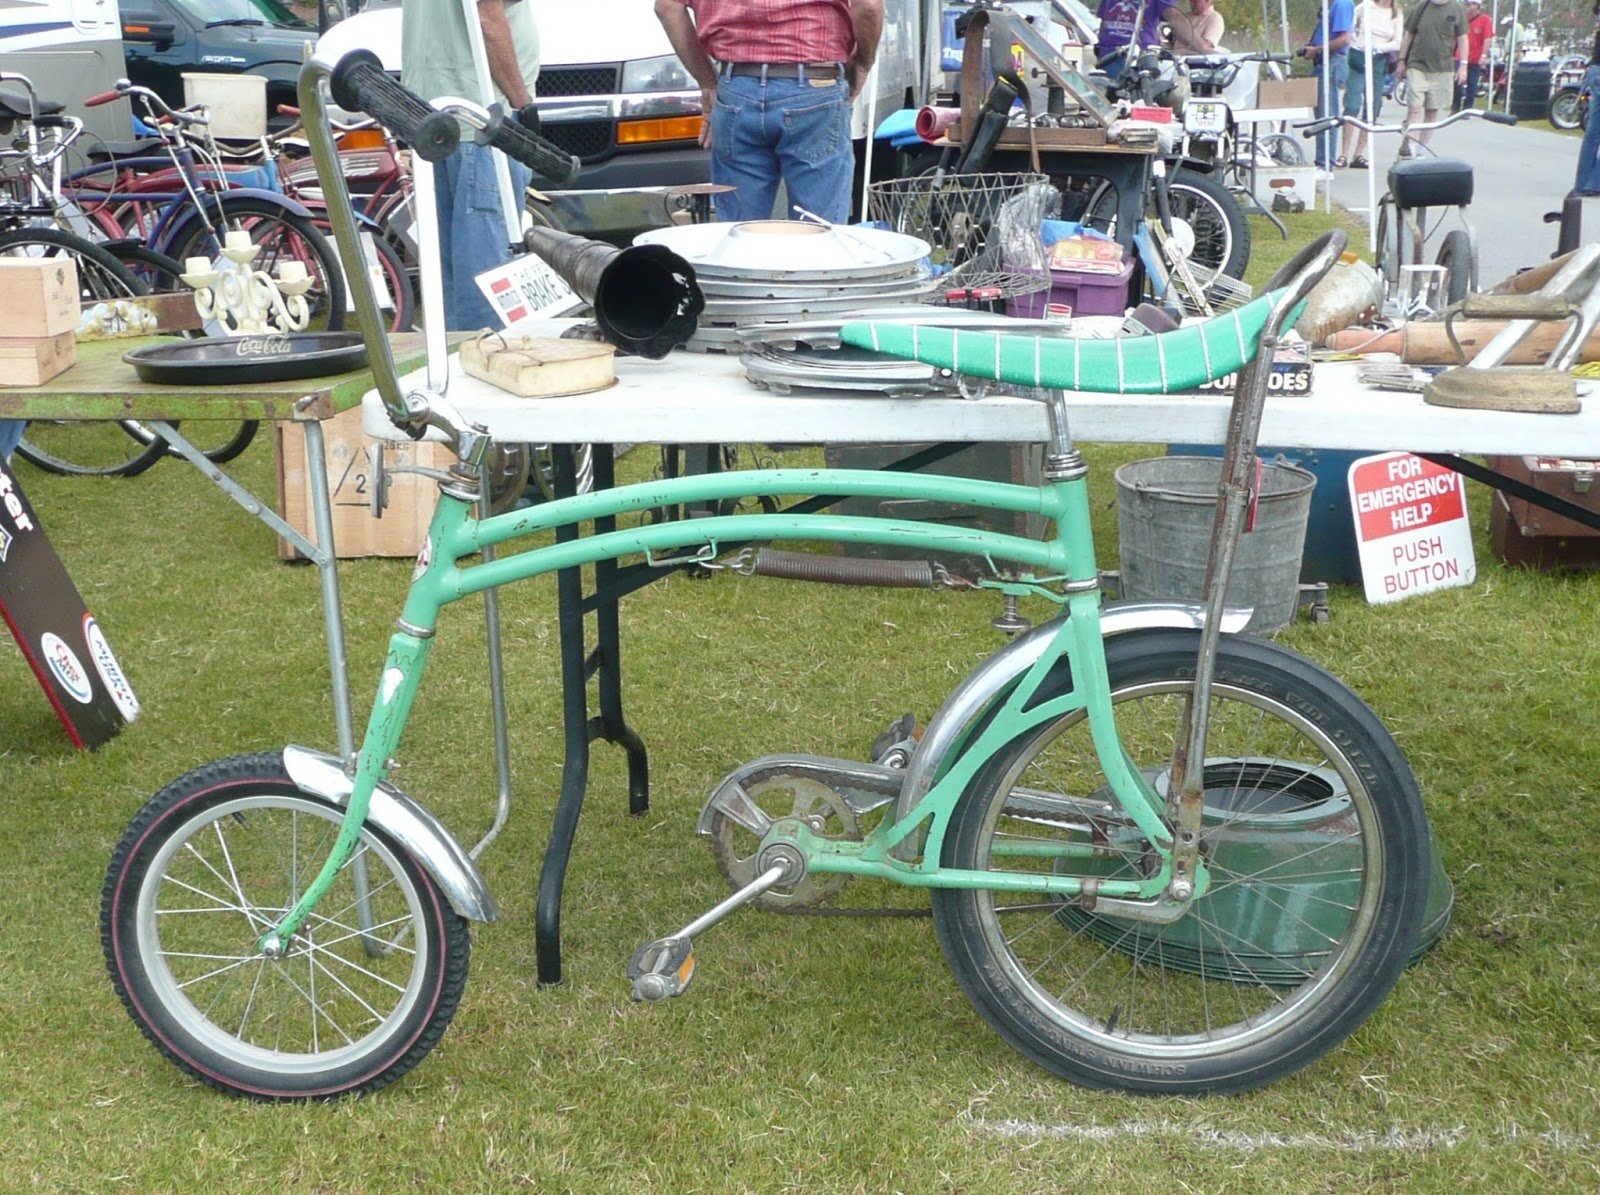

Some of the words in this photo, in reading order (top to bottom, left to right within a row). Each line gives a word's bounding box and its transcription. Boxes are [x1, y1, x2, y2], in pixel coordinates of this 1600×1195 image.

[520, 273, 562, 312] BRAKE
[1387, 456, 1423, 481] FOR
[1357, 471, 1457, 513] EMERGENCY
[1390, 502, 1432, 530] HELP
[1393, 536, 1443, 566] PUSH
[1384, 558, 1459, 595] BUTTON
[1104, 1055, 1187, 1077] SCHWINN
